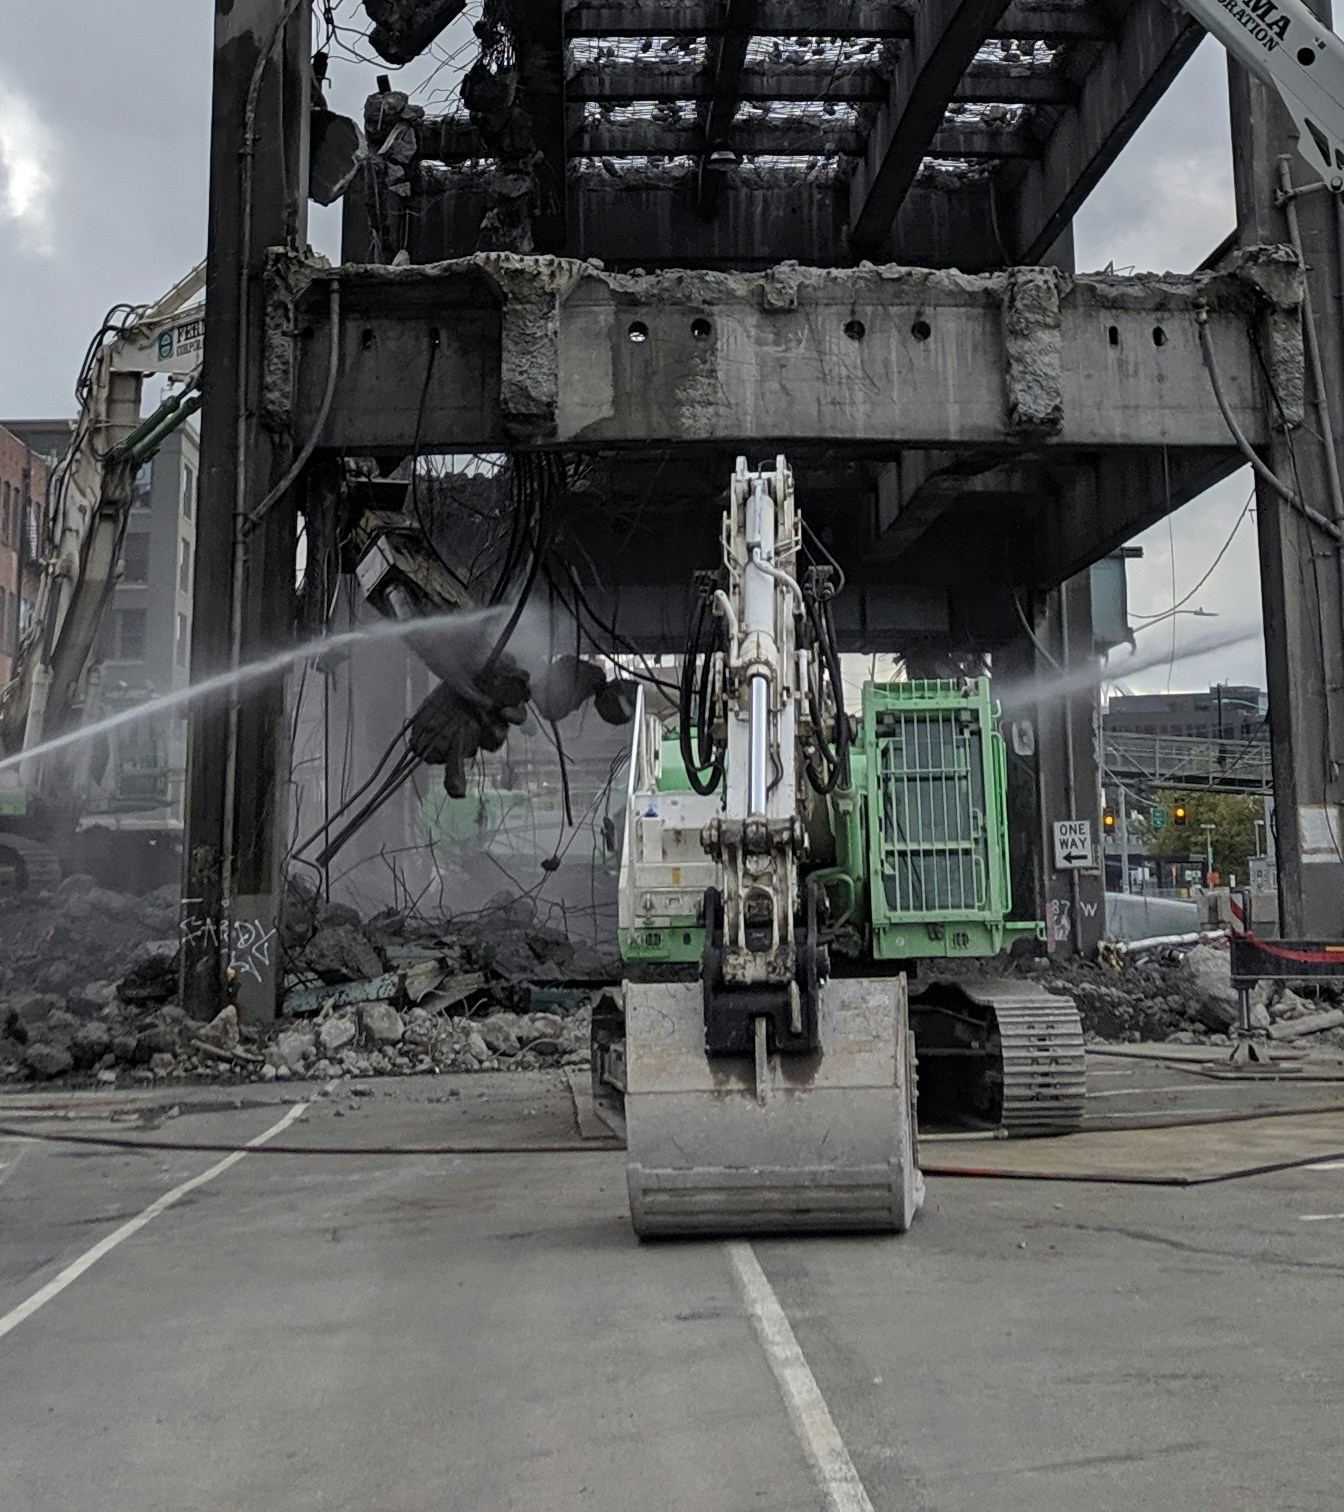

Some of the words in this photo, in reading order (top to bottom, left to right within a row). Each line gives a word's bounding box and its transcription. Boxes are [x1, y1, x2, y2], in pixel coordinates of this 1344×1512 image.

[1060, 823, 1086, 836] ONE
[1059, 837, 1087, 850] WAY
[1080, 901, 1098, 917] W
